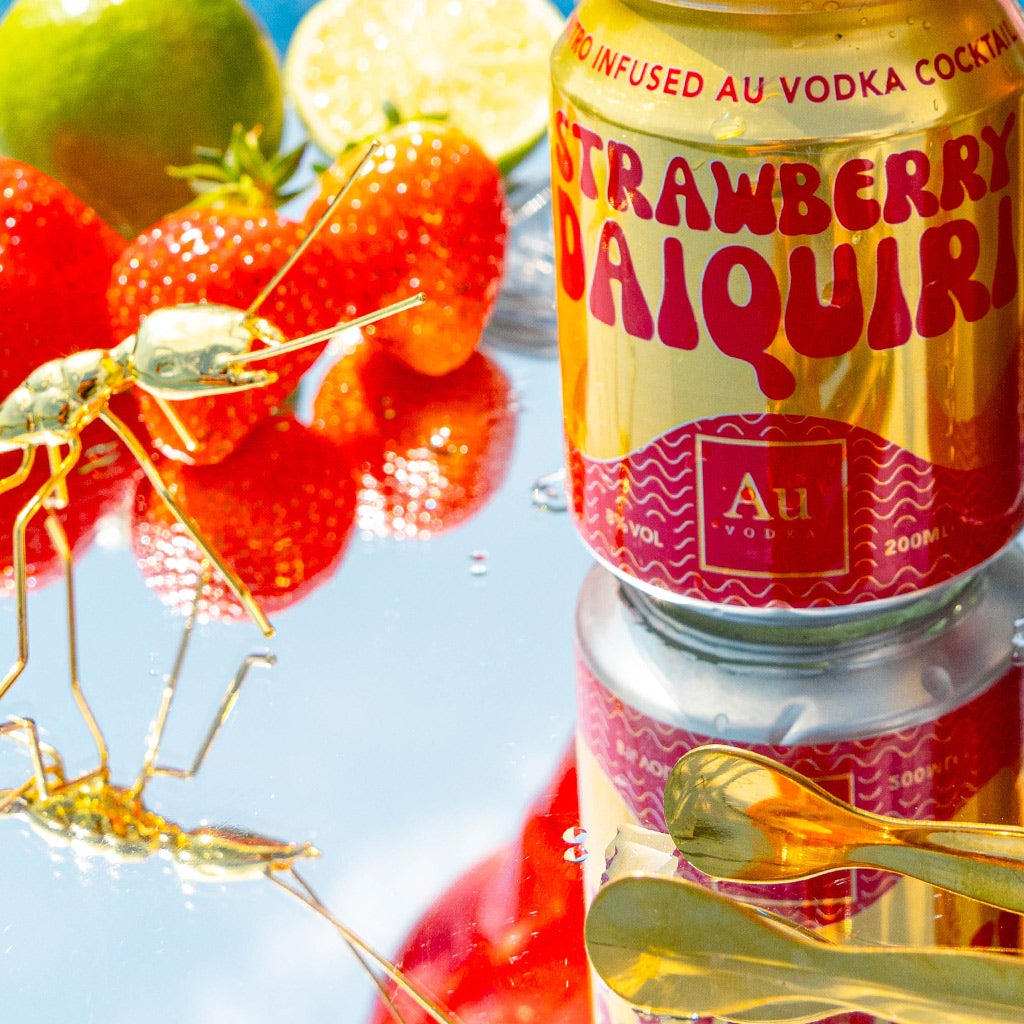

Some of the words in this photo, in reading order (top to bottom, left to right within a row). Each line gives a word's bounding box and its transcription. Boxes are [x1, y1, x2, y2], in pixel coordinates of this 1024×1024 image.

[592, 45, 704, 99] INFUSED
[715, 76, 765, 104] AU
[780, 66, 907, 104] VODKA
[914, 20, 1018, 86] COCKTAIL
[555, 109, 1016, 237] STRAWBERRY
[556, 186, 1019, 402] DAIQUIRI
[628, 520, 665, 548] VOL
[722, 471, 812, 521] Au
